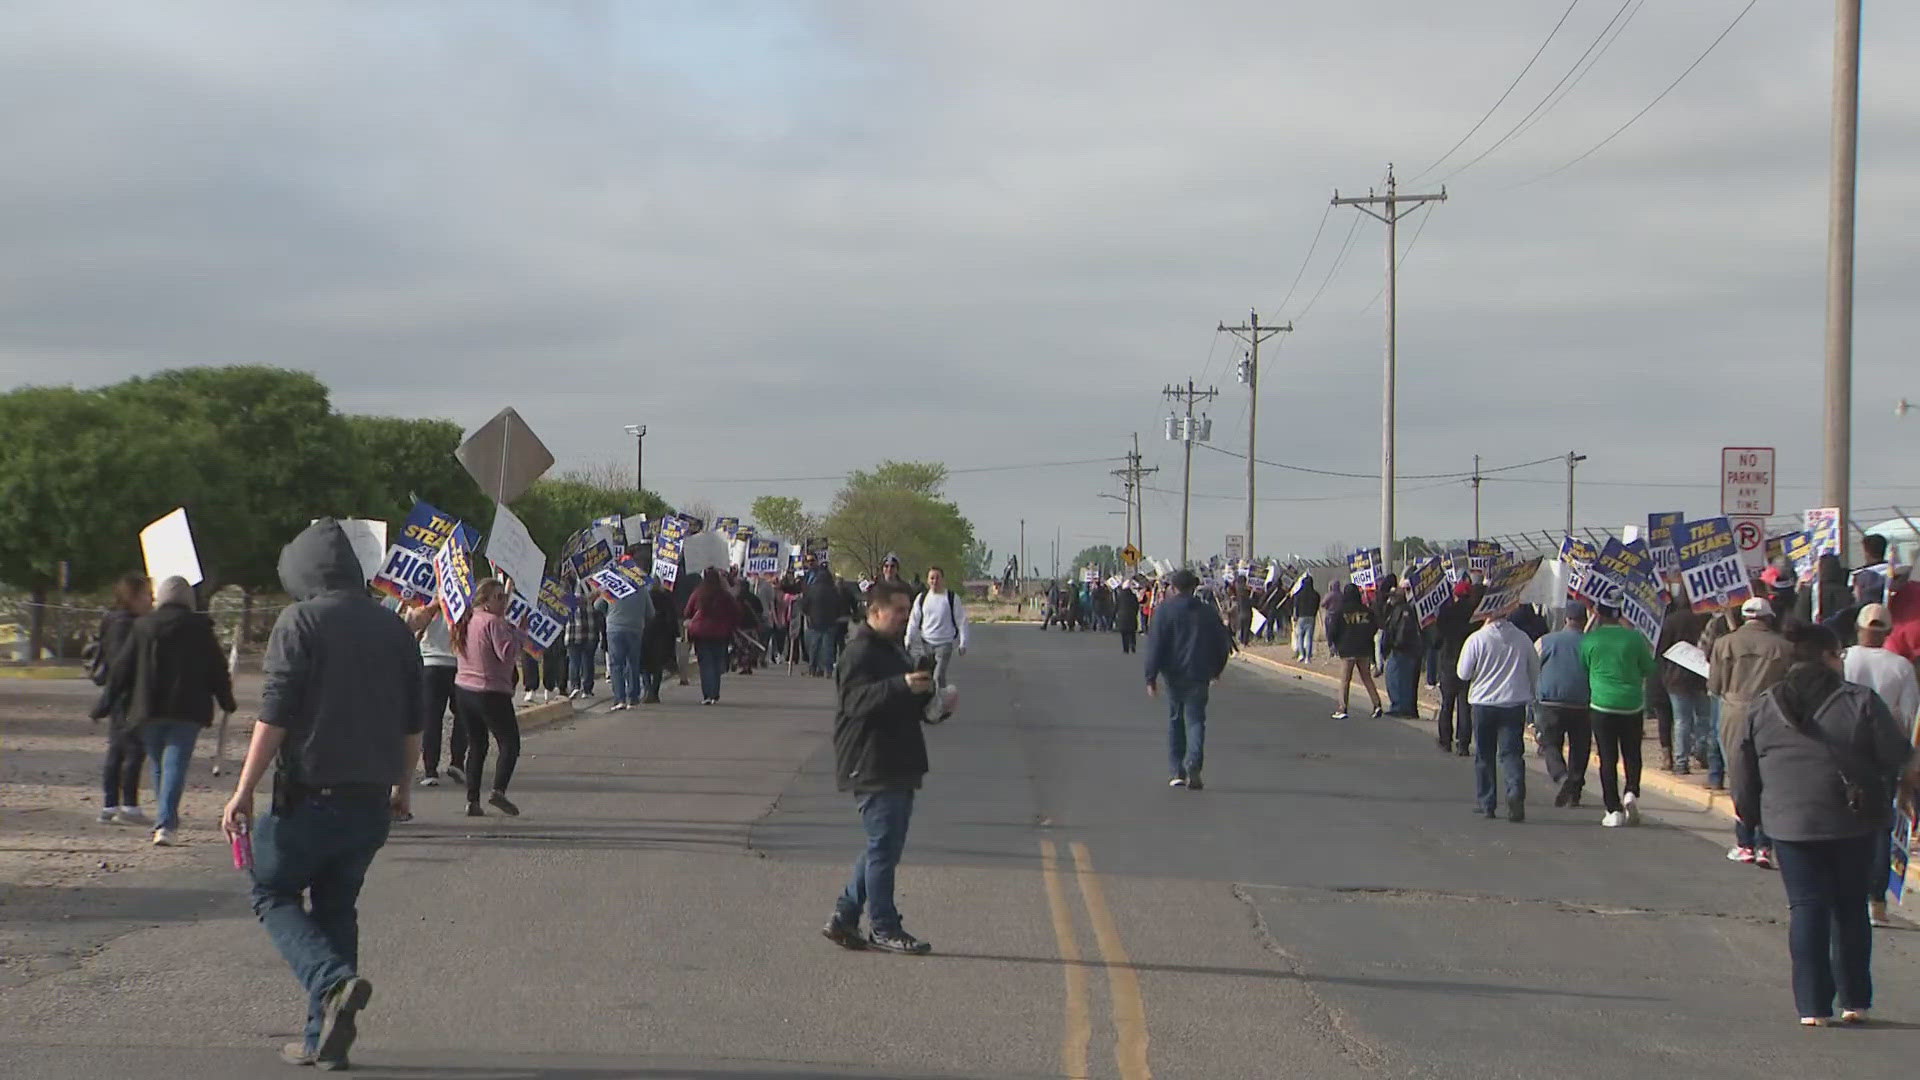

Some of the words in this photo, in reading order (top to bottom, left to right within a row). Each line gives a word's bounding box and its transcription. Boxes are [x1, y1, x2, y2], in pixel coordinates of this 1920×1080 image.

[1739, 453, 1758, 467] NO
[1727, 471, 1768, 485] PARKING
[1739, 488, 1757, 497] ANY
[1736, 500, 1760, 511] TIME
[1690, 521, 1716, 540] THE
[1681, 533, 1732, 560] STEAKS
[749, 560, 776, 571] HIGH
[1353, 569, 1373, 584] HIGH
[1688, 558, 1741, 598] HIGH
[1419, 582, 1447, 617] HIGH
[1623, 599, 1657, 641] HIGH
